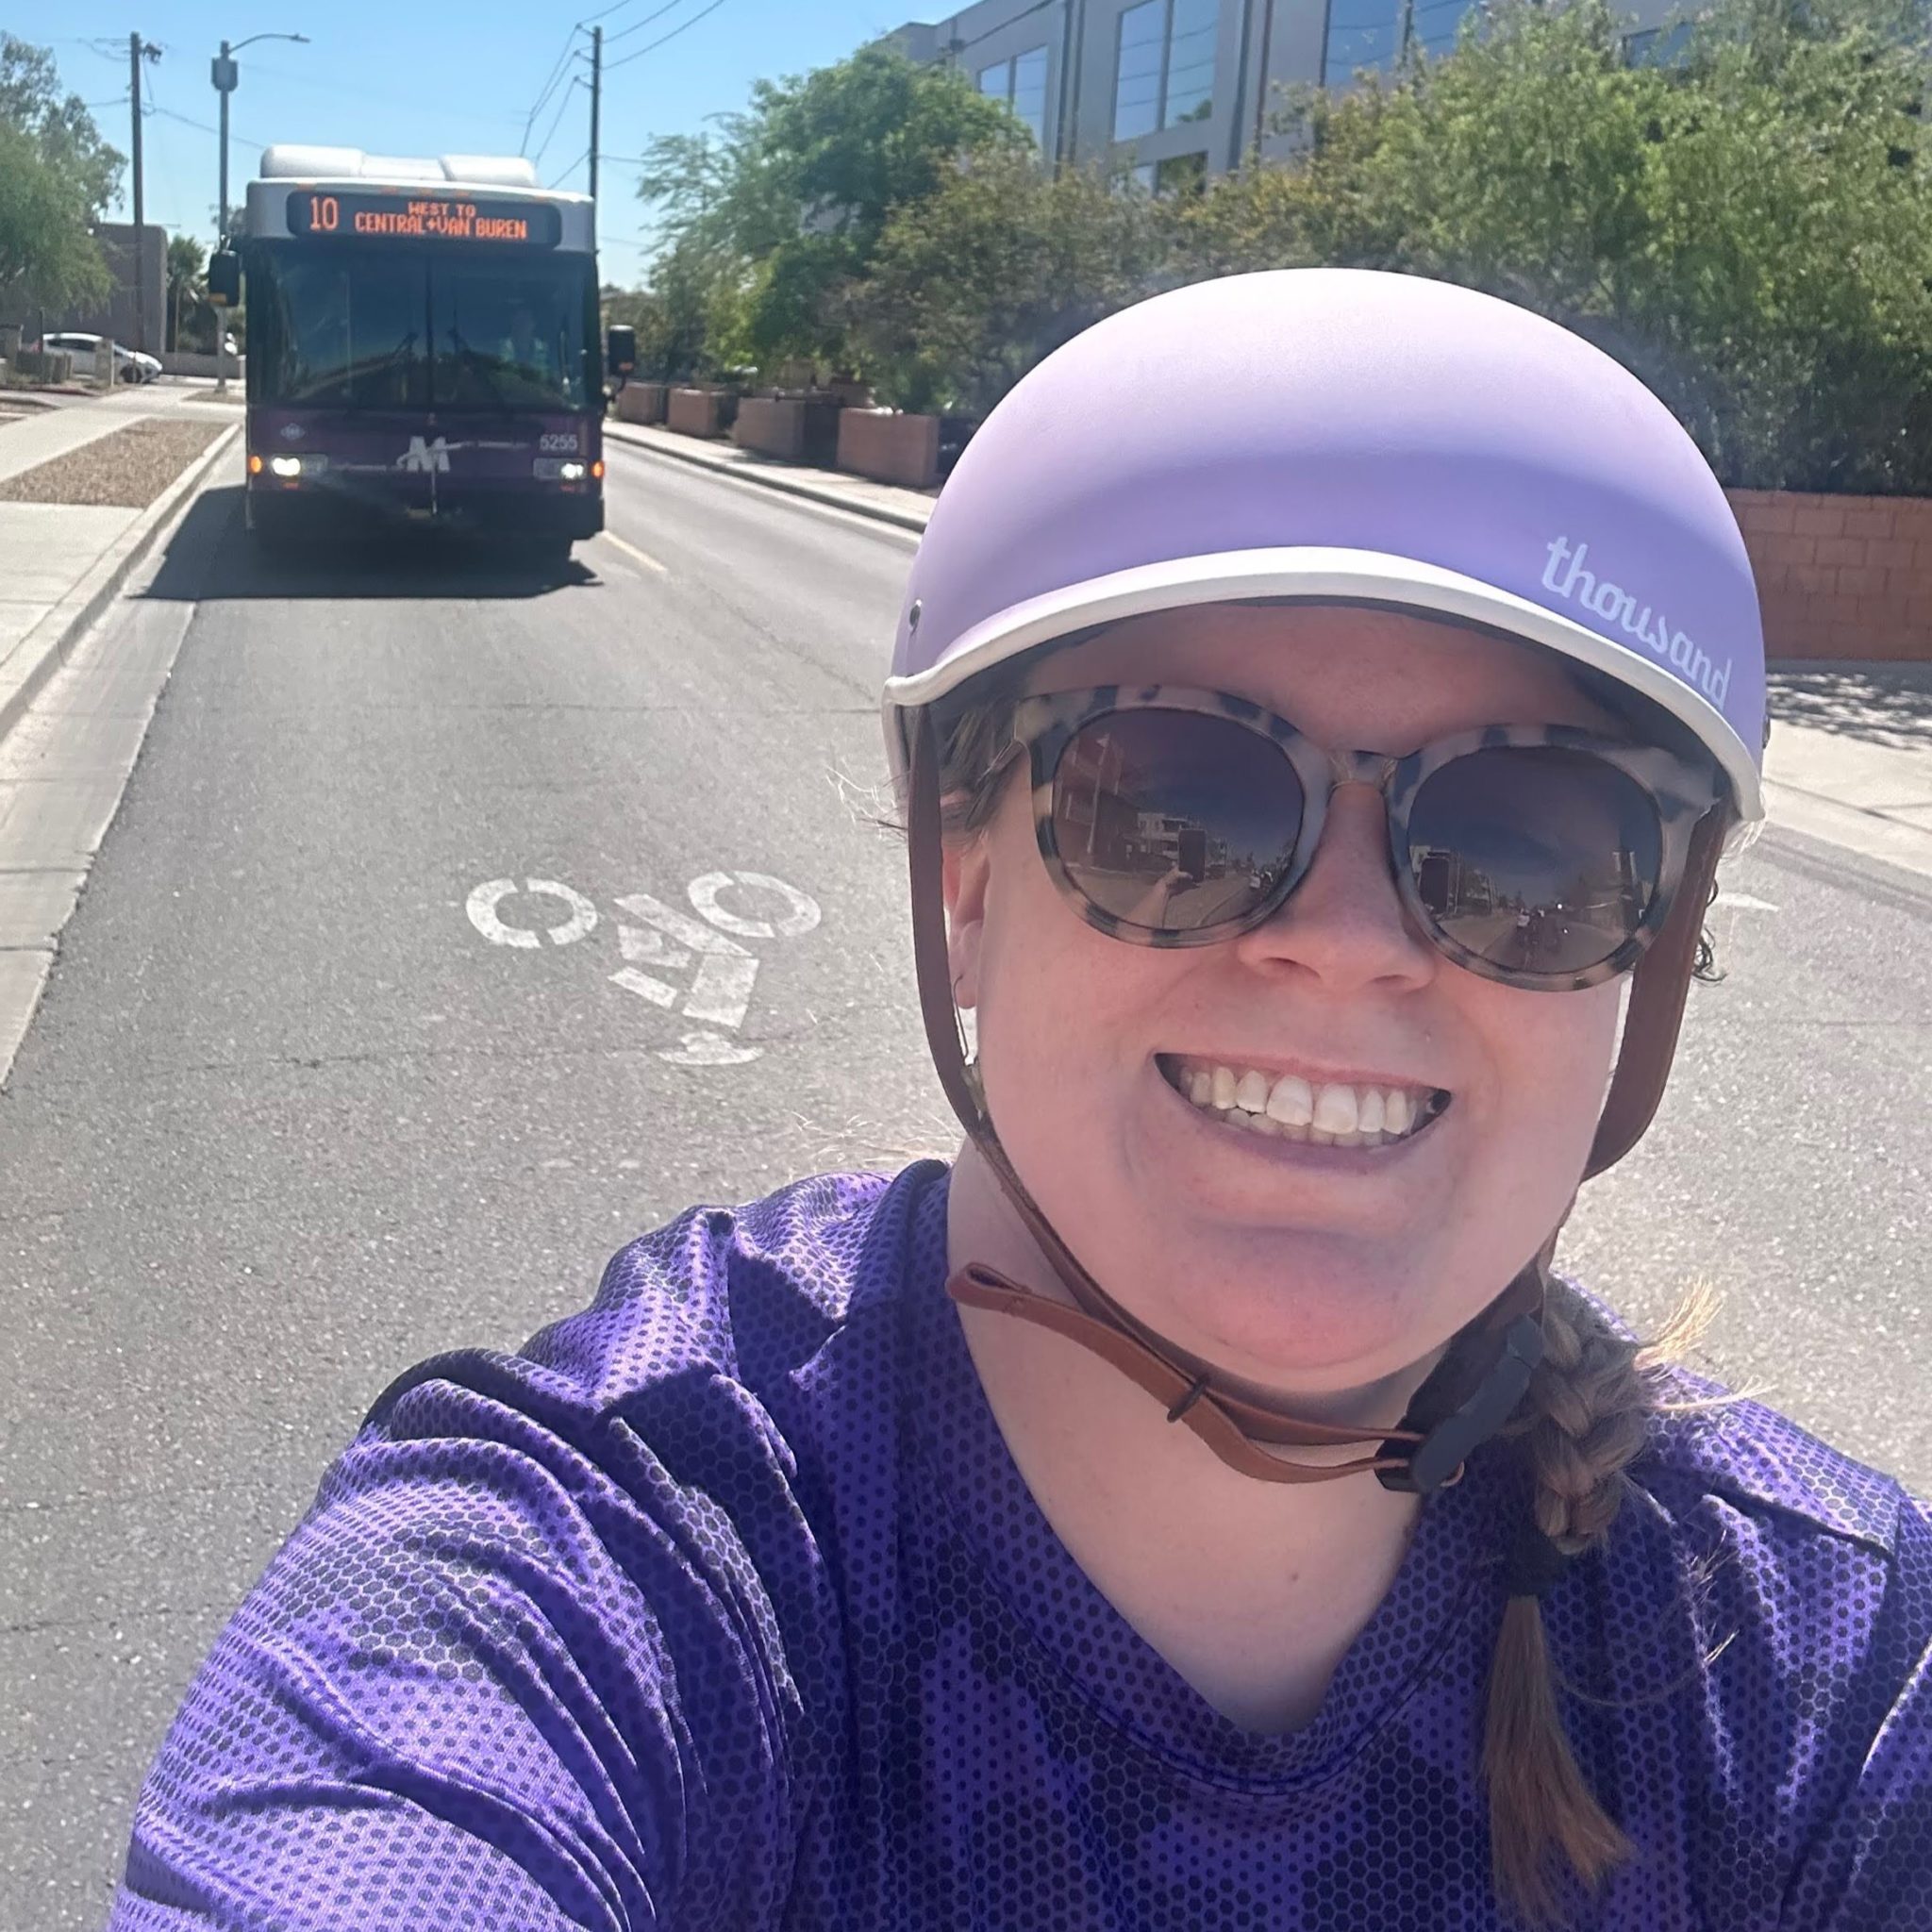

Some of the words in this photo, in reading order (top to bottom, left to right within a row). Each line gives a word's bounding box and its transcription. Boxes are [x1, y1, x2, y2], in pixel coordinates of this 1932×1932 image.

[309, 196, 339, 231] 10
[408, 201, 450, 216] WEST
[456, 203, 476, 218] TO
[475, 217, 526, 239] BUREN
[1541, 536, 1732, 712] thousand
